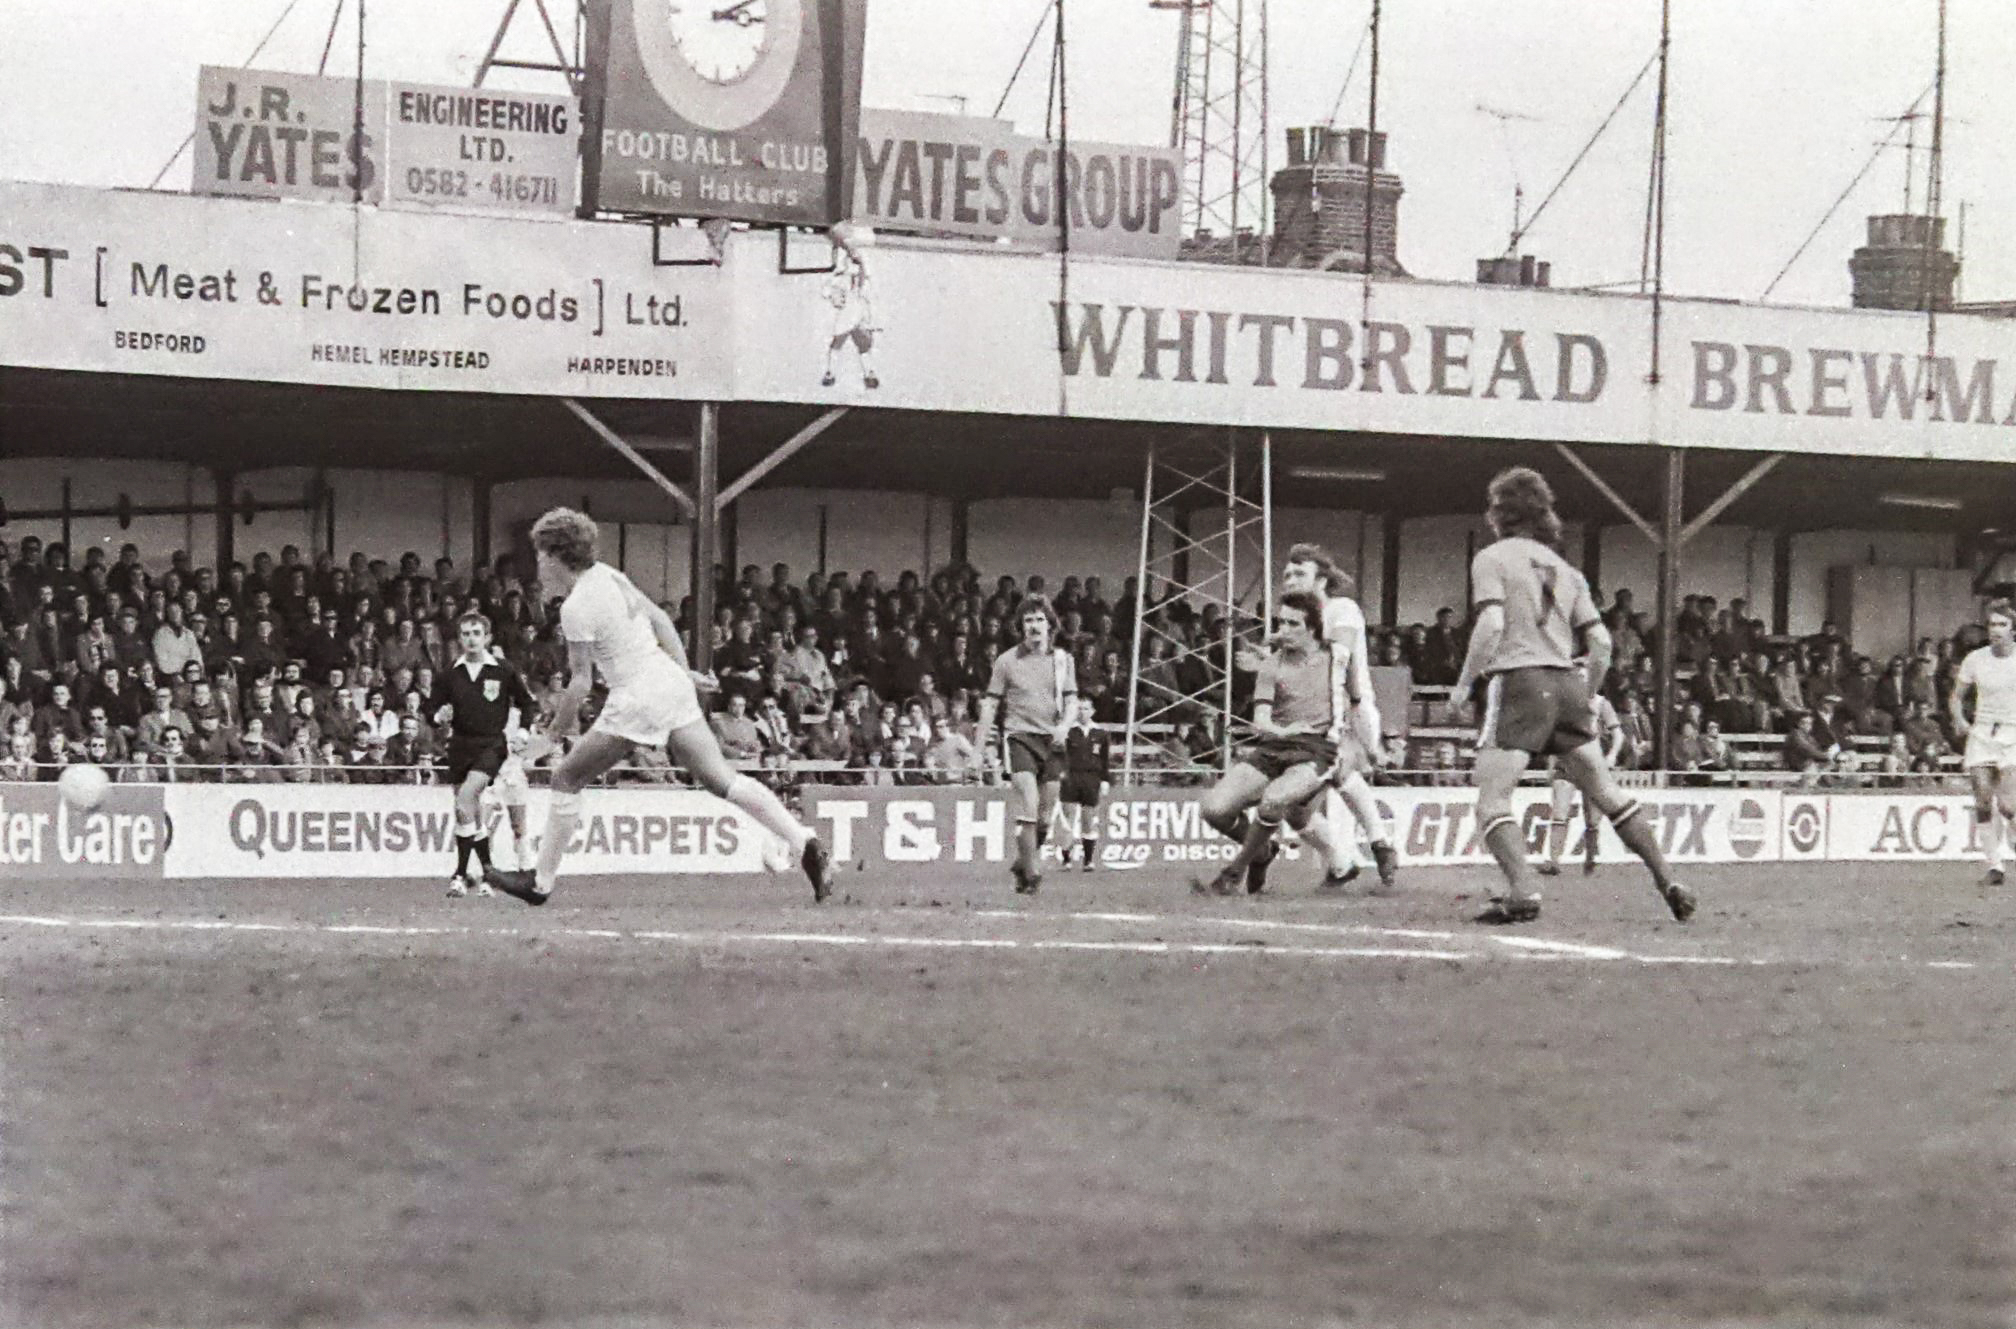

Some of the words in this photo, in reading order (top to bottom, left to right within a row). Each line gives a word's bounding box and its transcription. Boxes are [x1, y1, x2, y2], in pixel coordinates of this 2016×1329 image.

[208, 82, 306, 122] J.R.
[400, 91, 568, 134] ENGINEERING
[208, 121, 375, 190] YATES
[460, 134, 514, 163] LTD.
[602, 129, 743, 166] FOOTBALL
[761, 141, 828, 174] CLUB
[407, 167, 467, 197] 0582
[637, 171, 682, 198] The
[700, 176, 799, 206] Hatters
[852, 137, 1009, 225] YATES
[1021, 148, 1178, 234] GROUP
[0, 245, 69, 299] ST
[131, 262, 238, 302] Meat
[258, 271, 282, 306] &
[301, 275, 440, 315] Frozen
[463, 284, 579, 323] Foods
[626, 292, 689, 327] Ltd.
[115, 330, 207, 354] BEDFORD
[311, 344, 372, 365] HEMEL
[379, 346, 490, 370] HEMPSTEAD
[567, 356, 678, 378] HARPENDEN
[1055, 302, 1608, 403] WHITBREAD
[229, 798, 502, 860] QUEENSW
[817, 801, 868, 861] T
[883, 801, 942, 861] &
[955, 801, 1006, 861] H
[1870, 805, 1948, 854] AC
